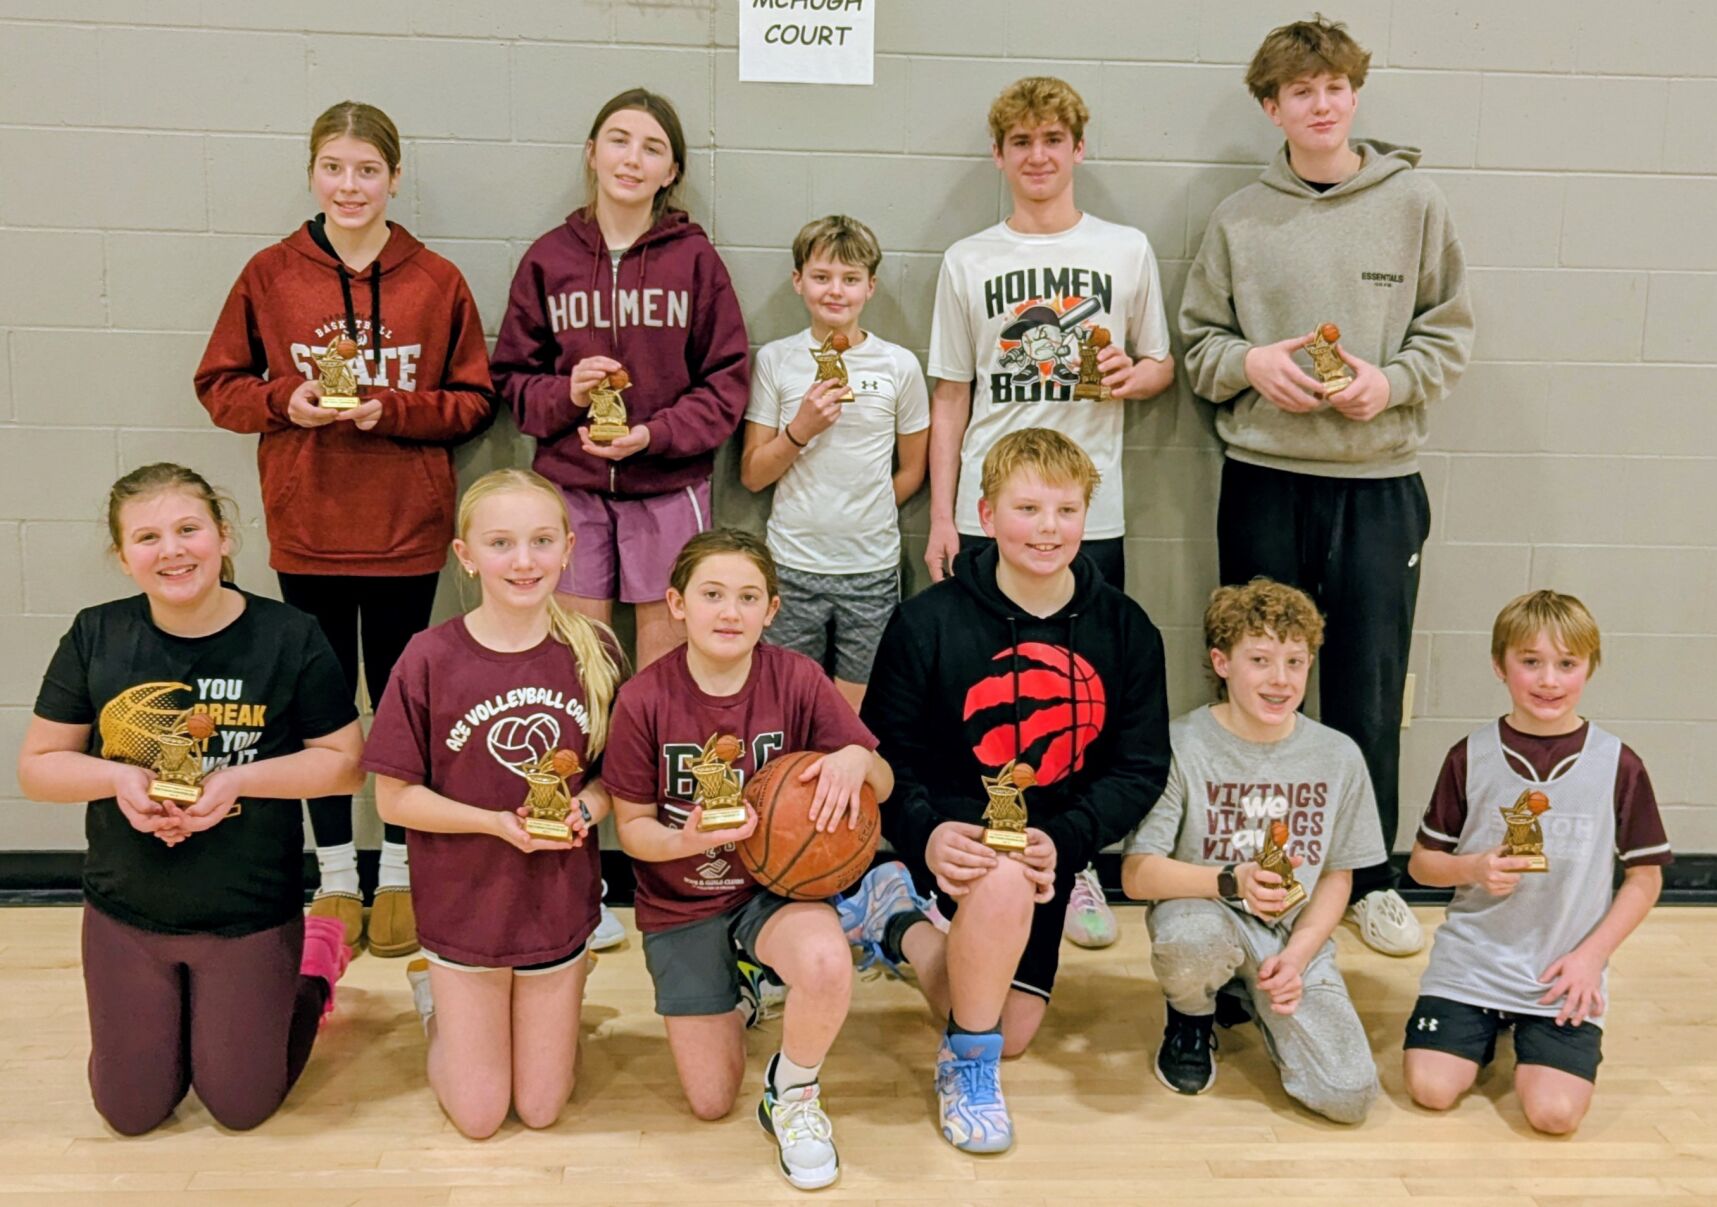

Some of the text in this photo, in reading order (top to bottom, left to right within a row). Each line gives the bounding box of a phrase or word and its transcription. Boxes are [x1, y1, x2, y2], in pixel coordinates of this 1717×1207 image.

[764, 24, 853, 46] COURT
[985, 267, 1112, 319] HOLMEN
[548, 288, 688, 333] HOLMEN
[315, 319, 393, 340] BASKTBLL
[991, 373, 1082, 403] BOO
[197, 678, 243, 700] YOU
[446, 687, 591, 752] ACE VOLLEYBALL CAM
[663, 731, 784, 804] BC
[1242, 796, 1289, 818] we
[1206, 809, 1324, 837] VIKGS
[1232, 829, 1278, 850] ar
